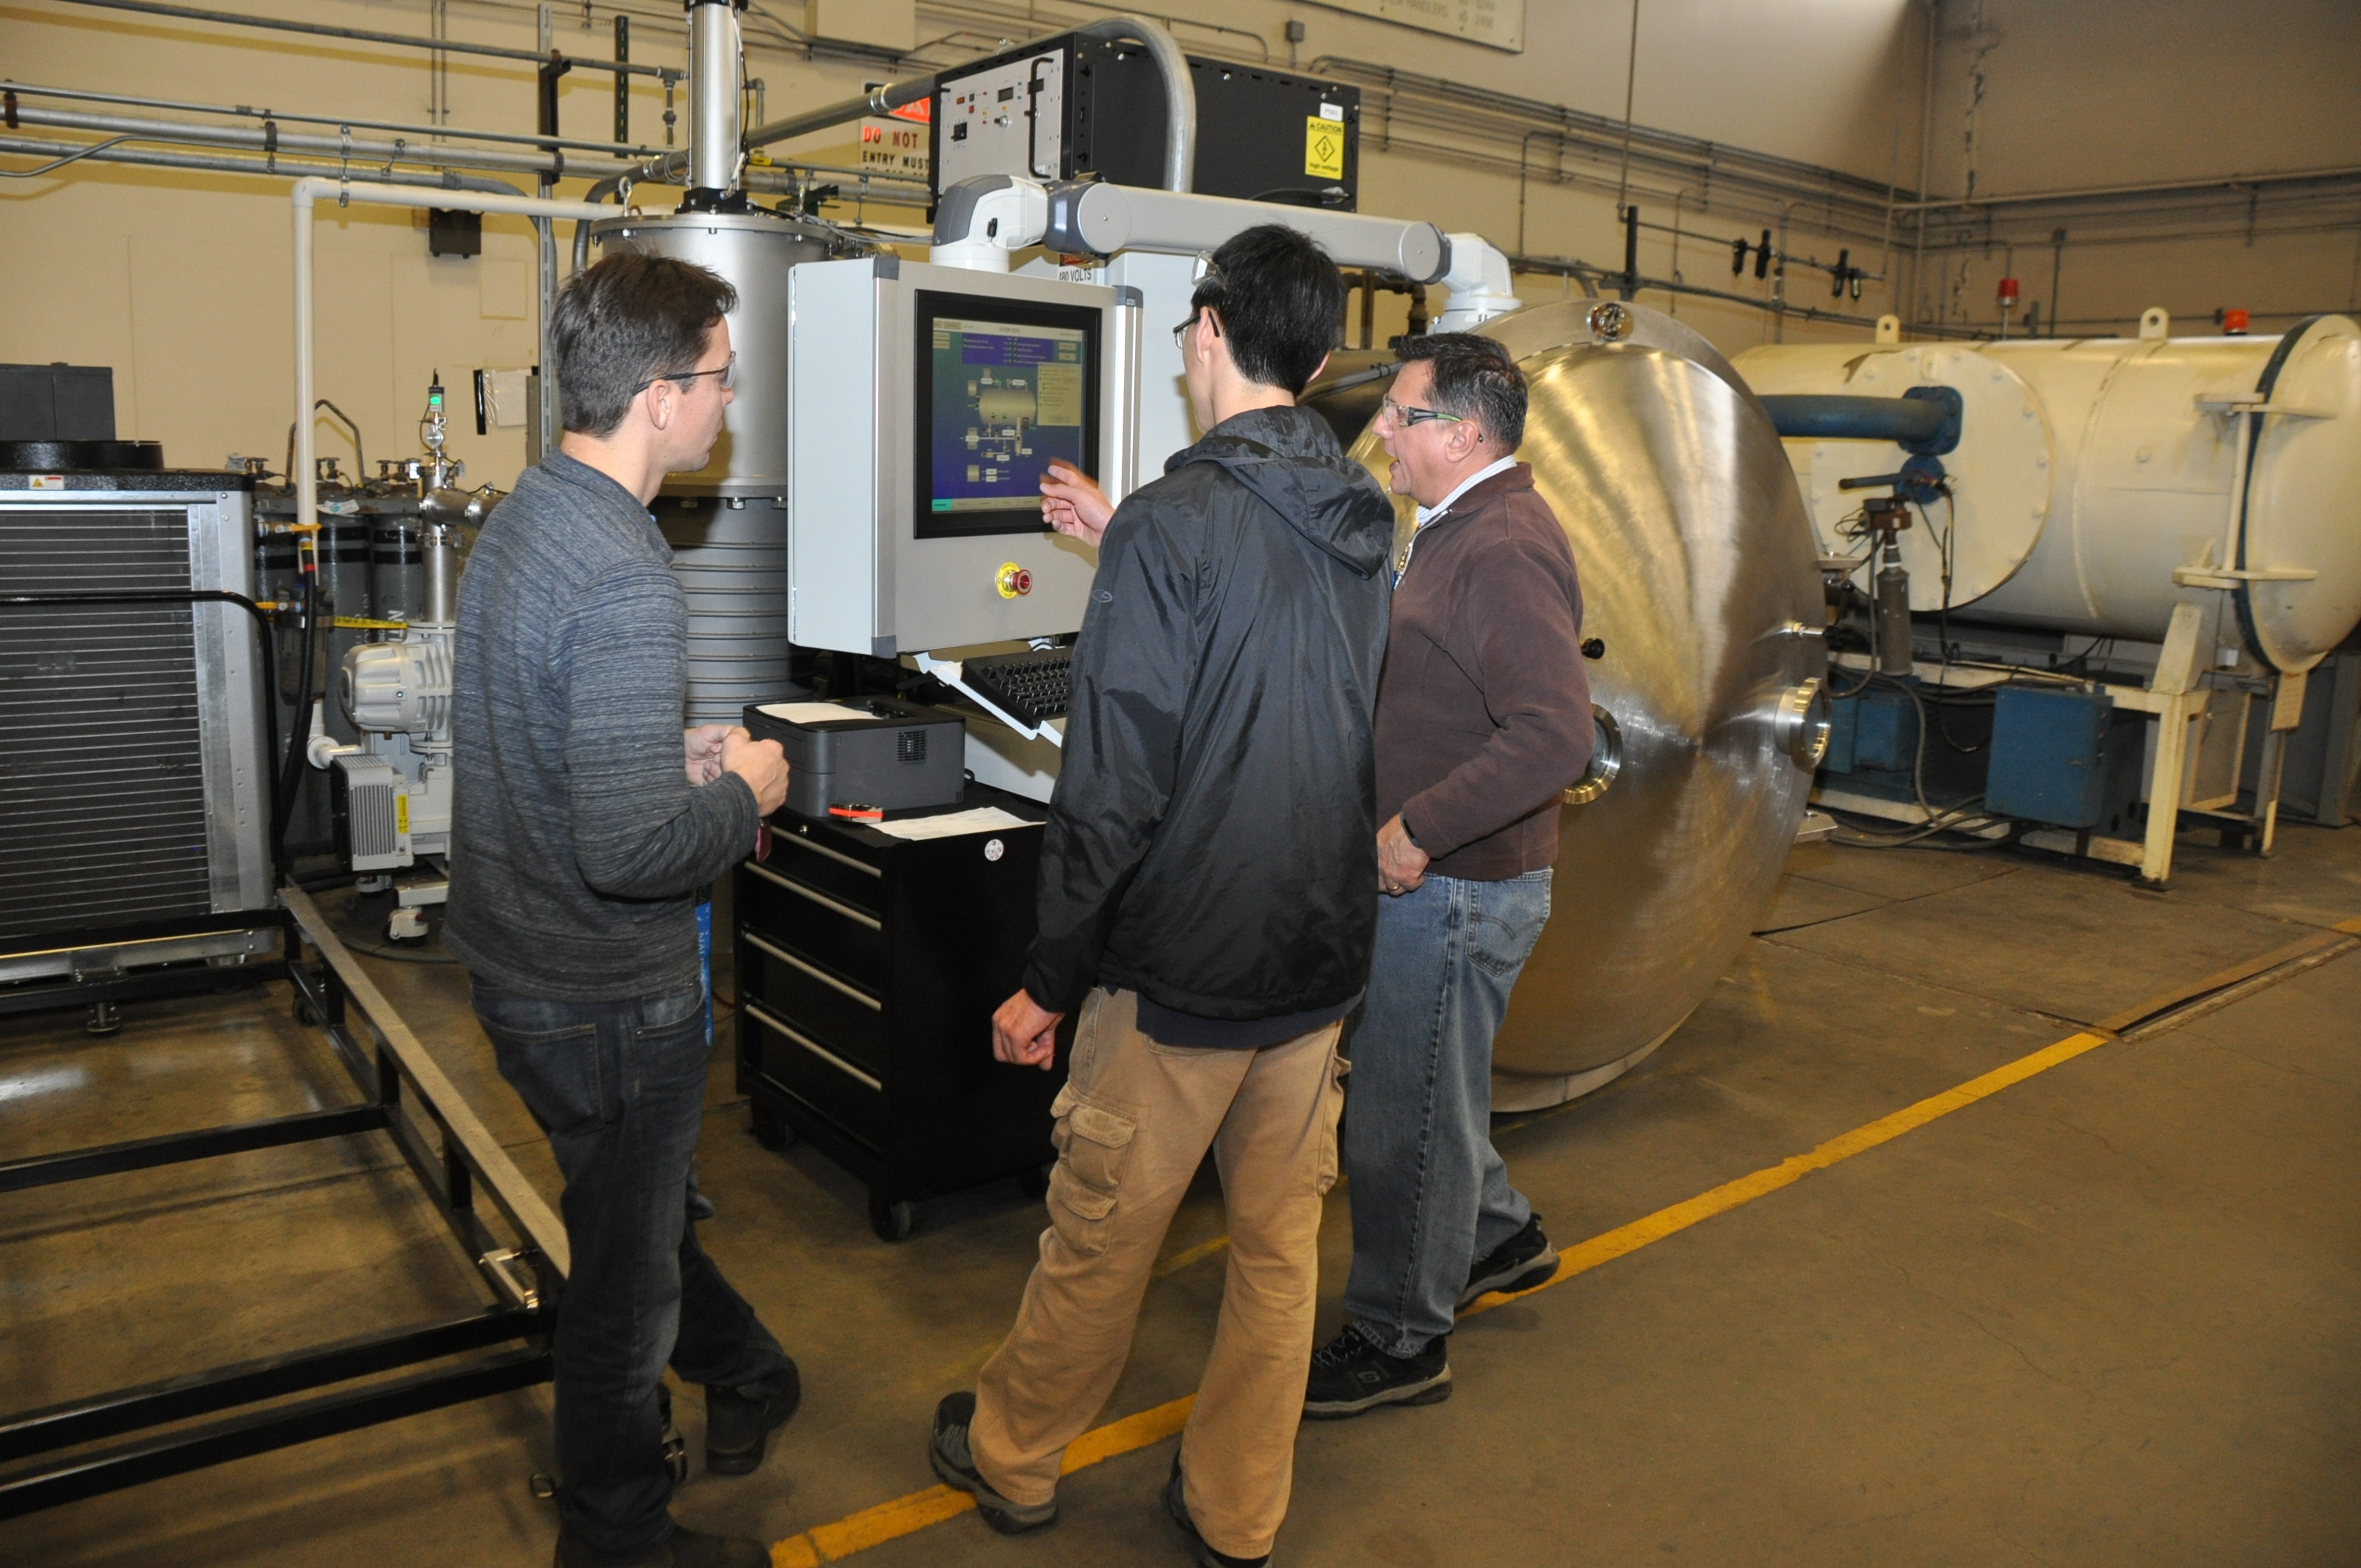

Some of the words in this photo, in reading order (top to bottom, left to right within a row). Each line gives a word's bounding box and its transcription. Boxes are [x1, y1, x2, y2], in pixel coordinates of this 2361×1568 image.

[1316, 122, 1343, 133] CAUTION
[862, 126, 881, 144] DO
[893, 131, 918, 149] NOT
[863, 150, 895, 165] ENTRY
[903, 156, 930, 170] MUST
[1070, 268, 1092, 282] VOLTS
